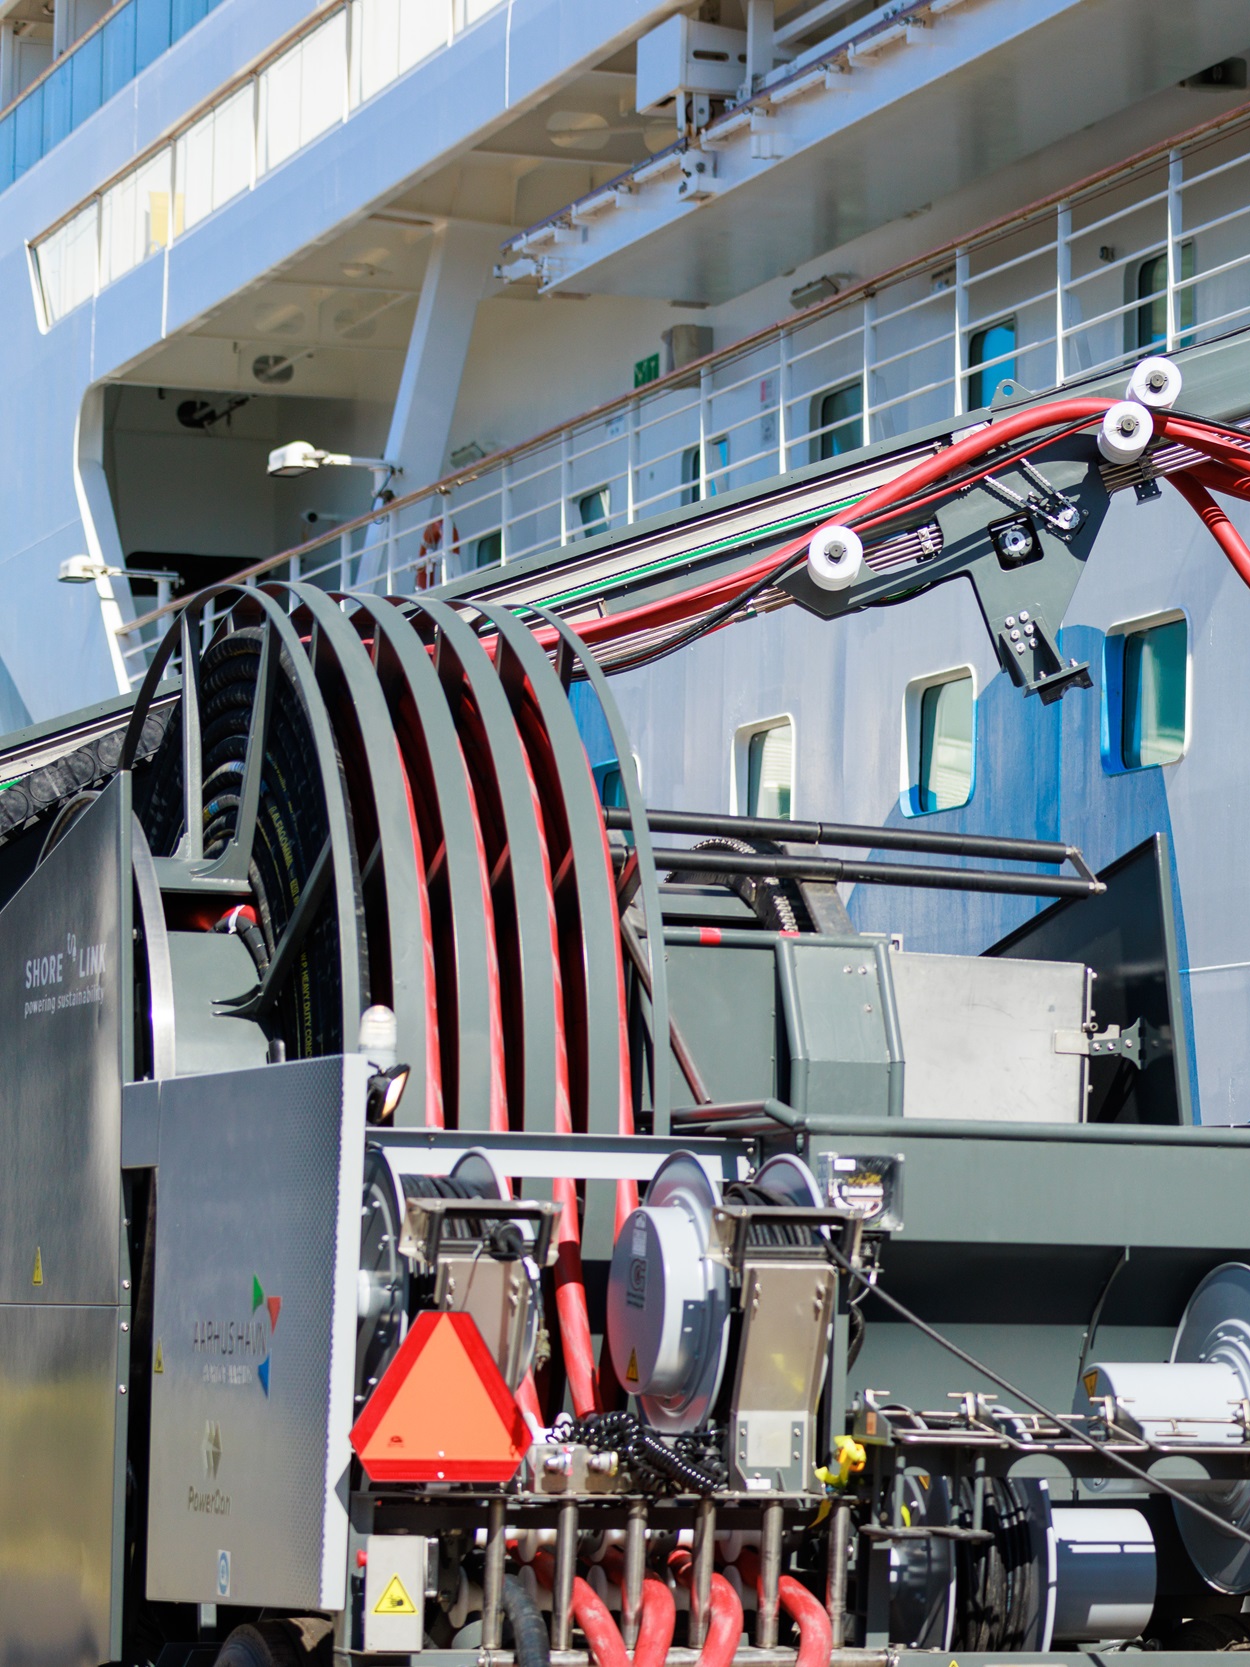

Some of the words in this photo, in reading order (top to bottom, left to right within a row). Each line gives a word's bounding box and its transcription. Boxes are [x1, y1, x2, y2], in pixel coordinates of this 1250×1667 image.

[25, 952, 64, 989] SHORE
[79, 943, 107, 978] LINK
[24, 993, 56, 1019] powering
[57, 983, 105, 1009] sustainability
[302, 969, 311, 1000] HEAVY
[303, 1001, 312, 1031] DUTY
[192, 1320, 235, 1355] AARHUS
[188, 1485, 231, 1516] PowerCon
